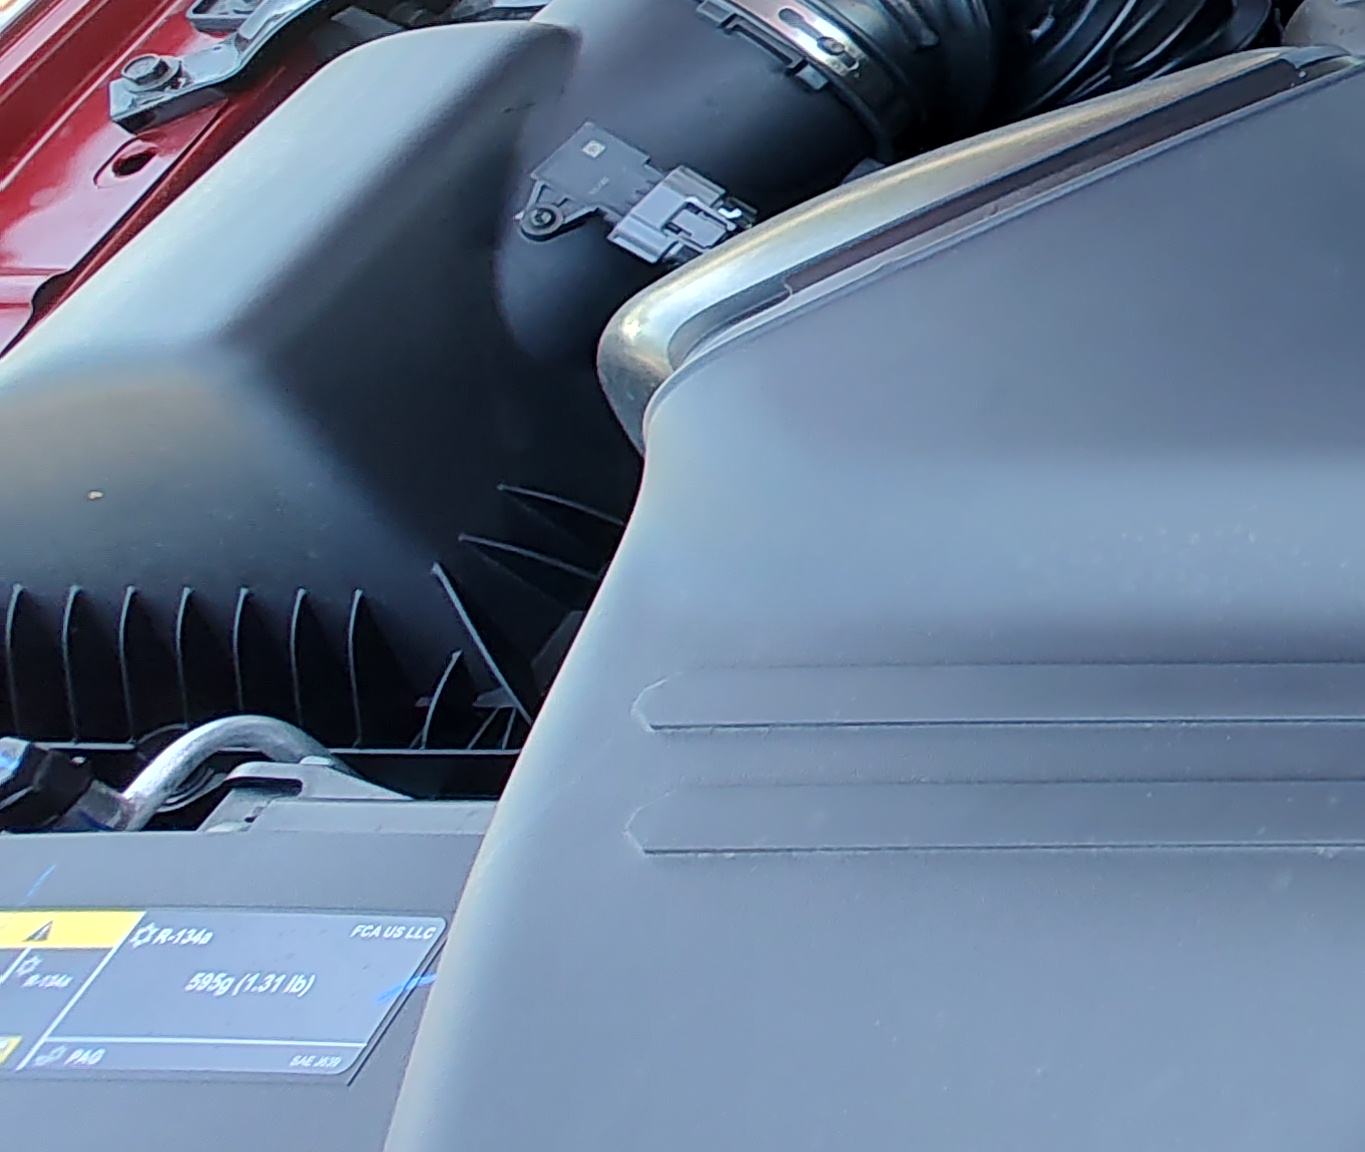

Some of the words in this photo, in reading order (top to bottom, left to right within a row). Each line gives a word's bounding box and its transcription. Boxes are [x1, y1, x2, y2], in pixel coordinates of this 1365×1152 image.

[153, 928, 214, 946] R-134a
[349, 924, 384, 940] FCA
[382, 925, 405, 940] US
[404, 926, 437, 941] LLC
[184, 971, 236, 997] 595g
[231, 972, 286, 997] (1.31
[283, 973, 317, 998] lb)
